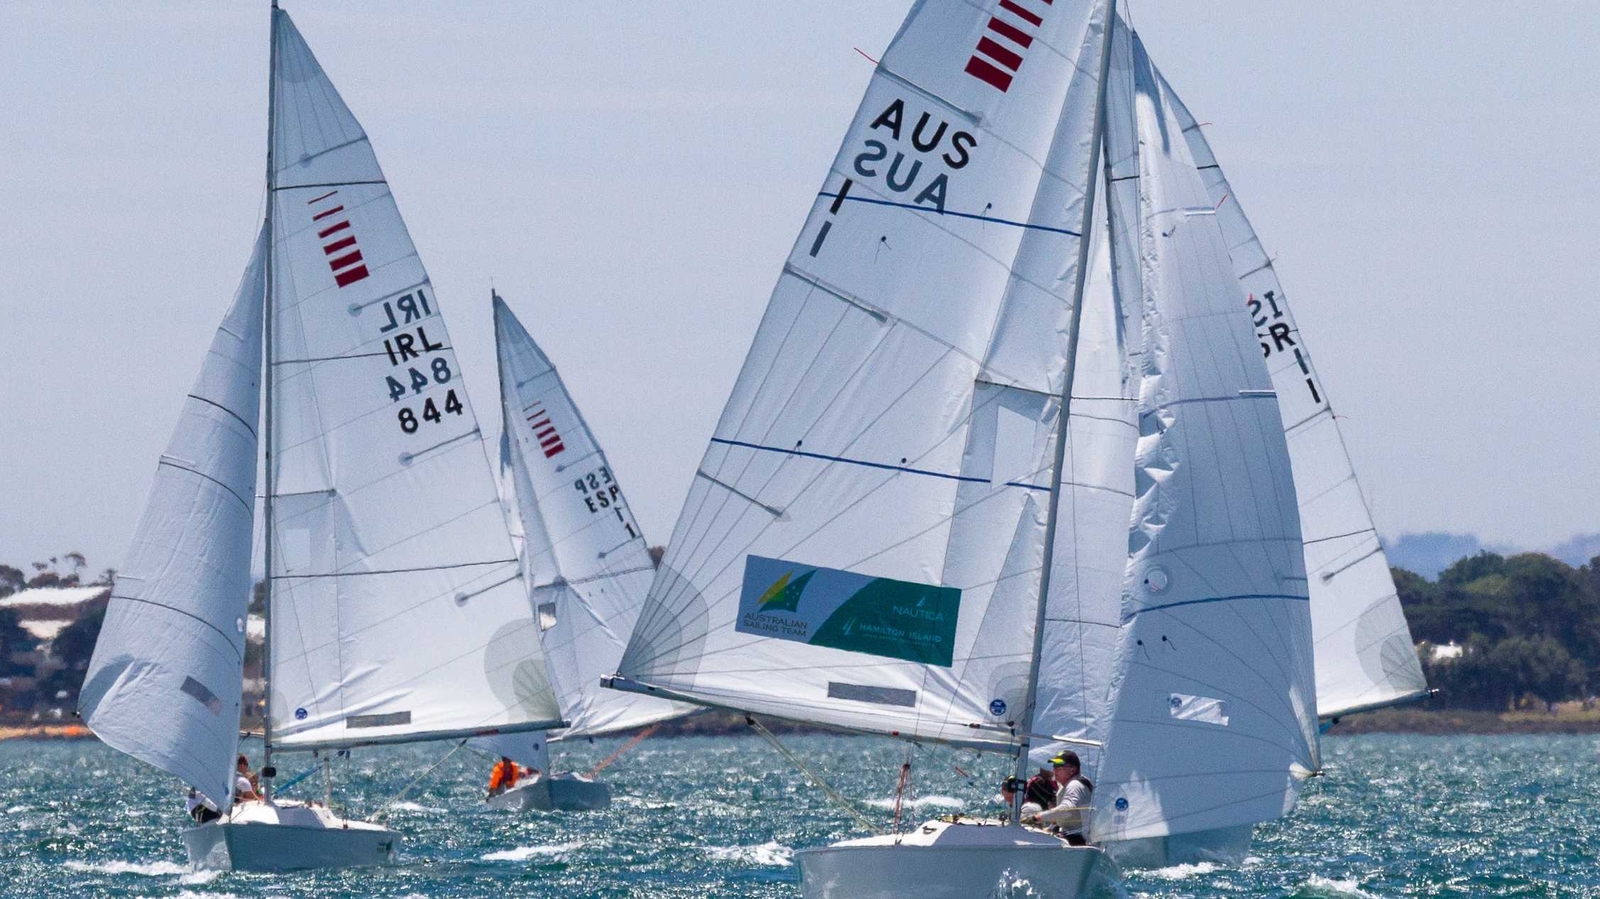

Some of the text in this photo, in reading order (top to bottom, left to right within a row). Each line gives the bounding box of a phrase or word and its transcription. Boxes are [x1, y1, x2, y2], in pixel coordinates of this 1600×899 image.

[870, 99, 977, 169] AUS
[384, 327, 443, 366] IRL
[398, 389, 463, 434] 844
[584, 485, 619, 513] ESP
[744, 612, 808, 629] AUSTRALIAN
[893, 605, 944, 622] NAUTICA
[743, 620, 807, 637] SAILING TEAM
[860, 624, 905, 637] HAMILTON
[909, 632, 942, 643] ISLAND
